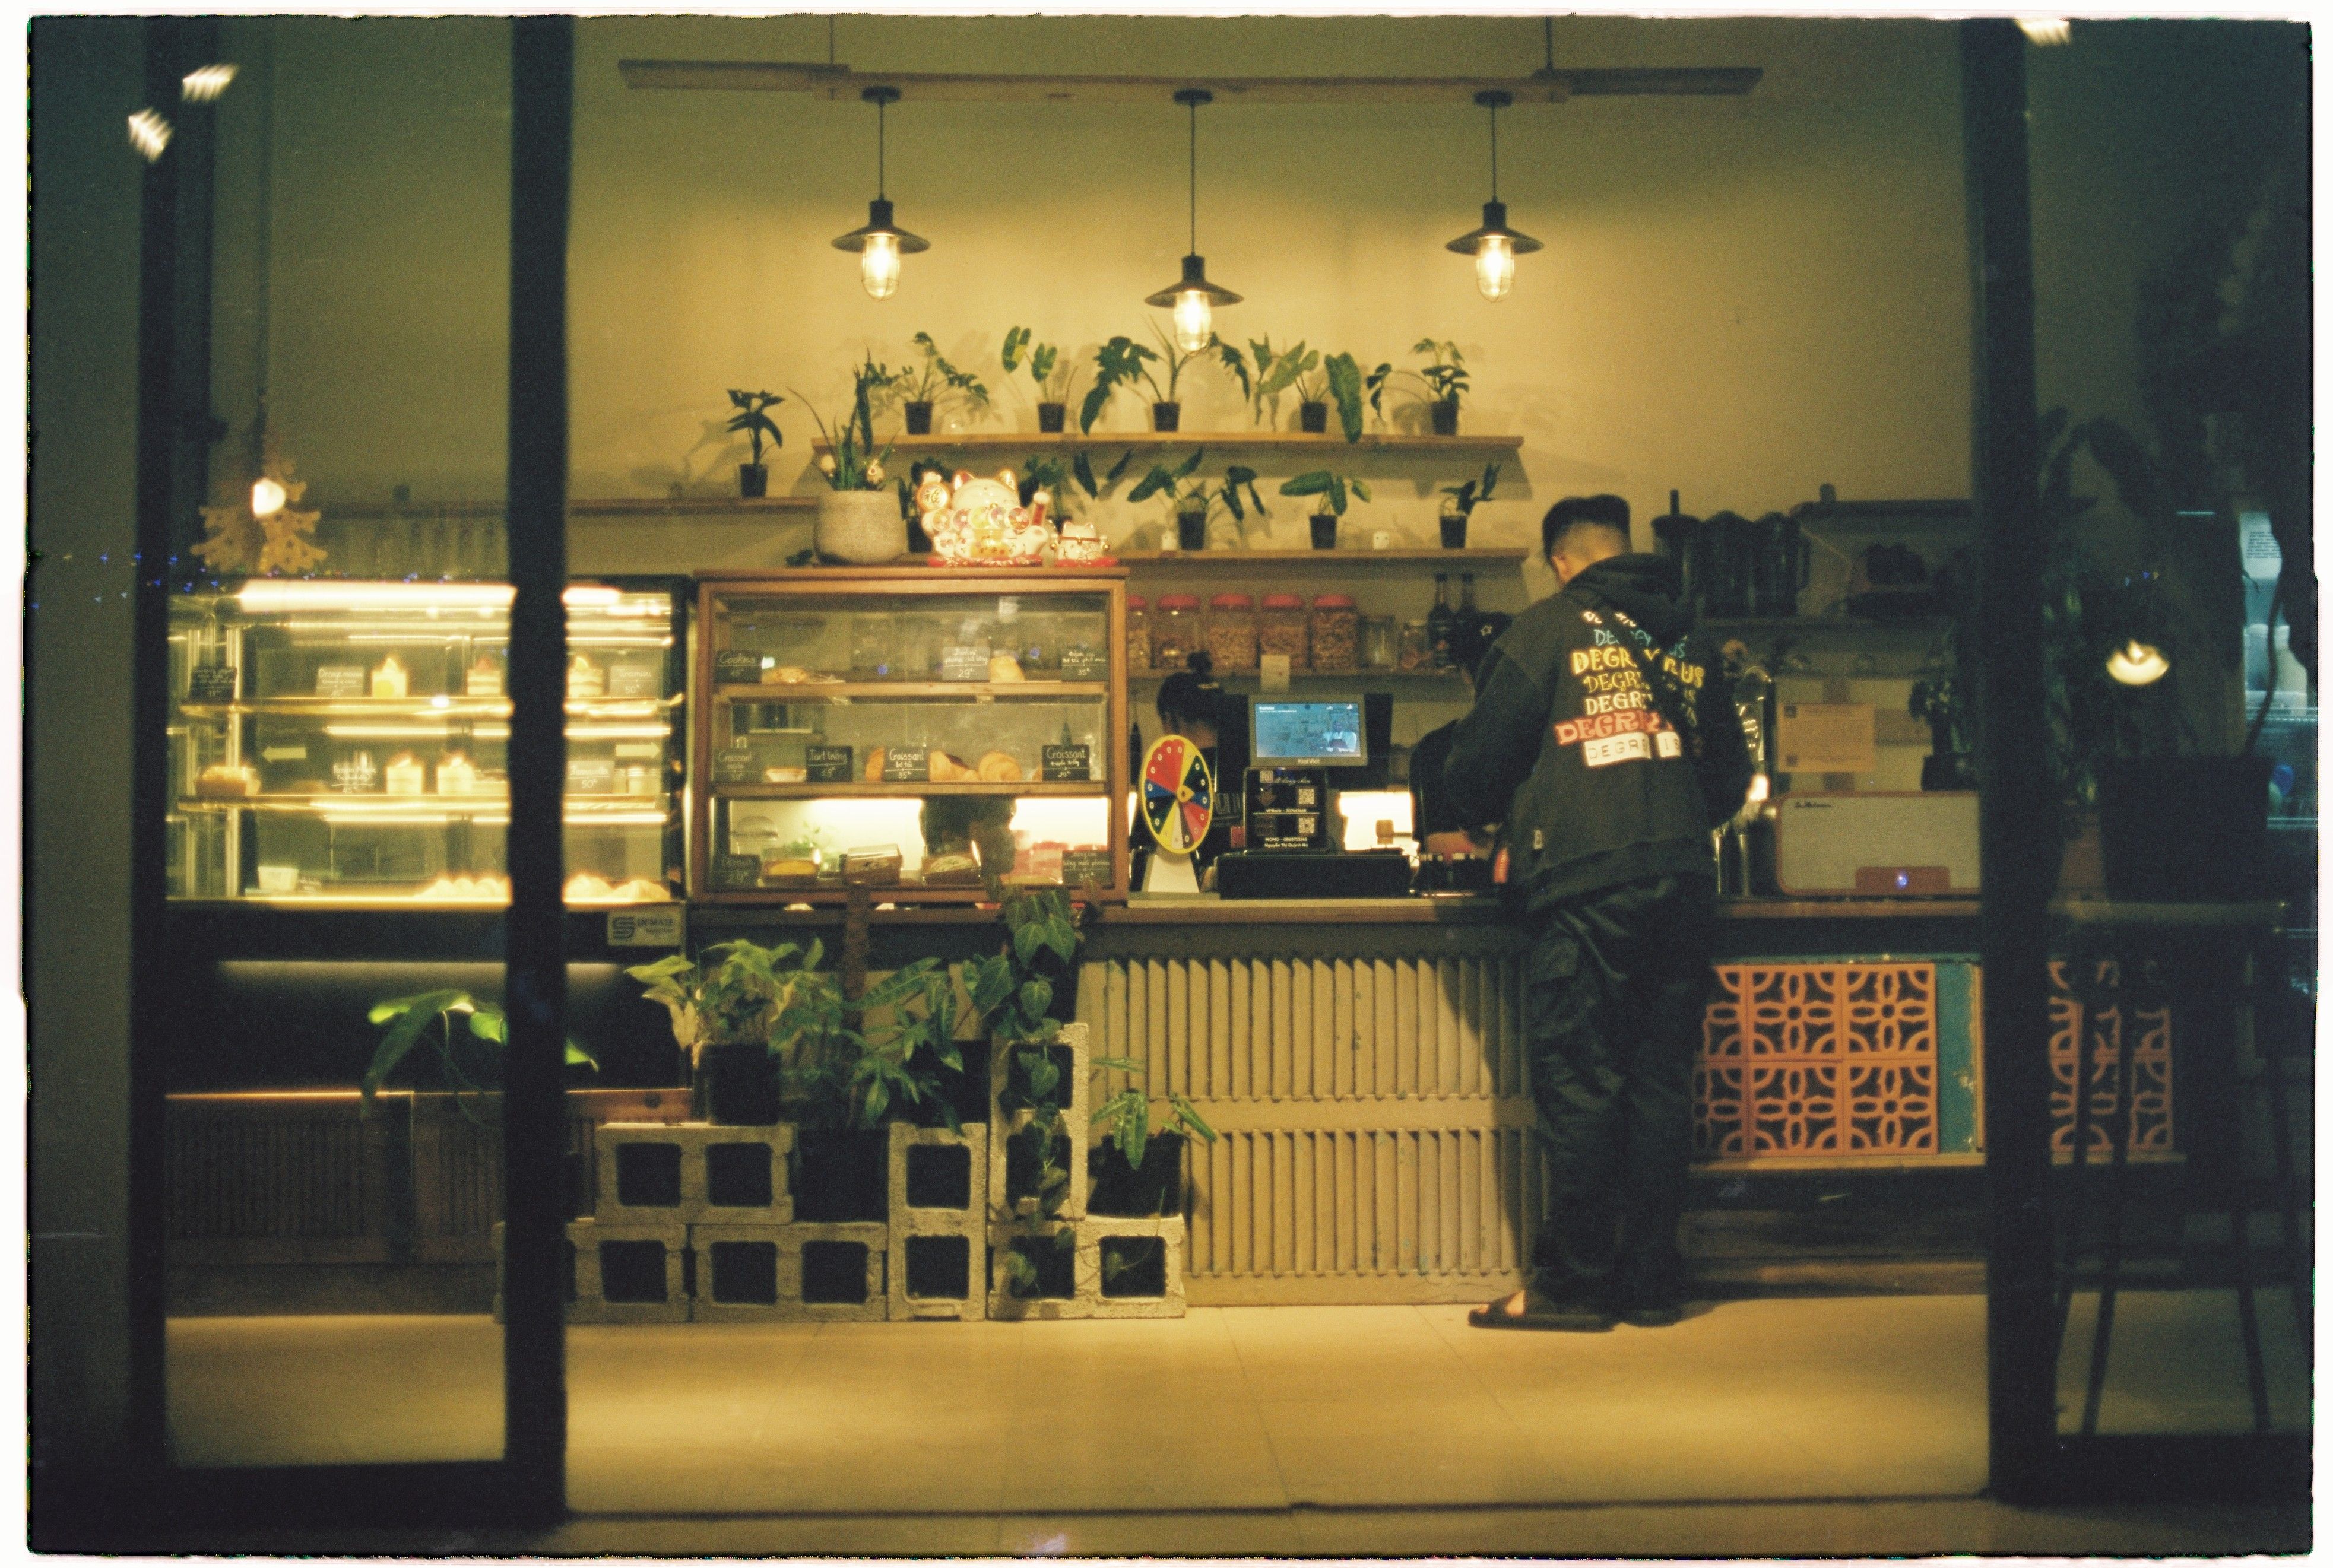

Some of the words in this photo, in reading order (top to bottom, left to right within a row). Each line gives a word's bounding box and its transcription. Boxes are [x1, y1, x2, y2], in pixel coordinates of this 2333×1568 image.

[1573, 646, 1638, 675] DEGR
[1583, 671, 1650, 694] DEGR
[1585, 691, 1653, 716] DEGR
[1046, 747, 1086, 760] Croissant
